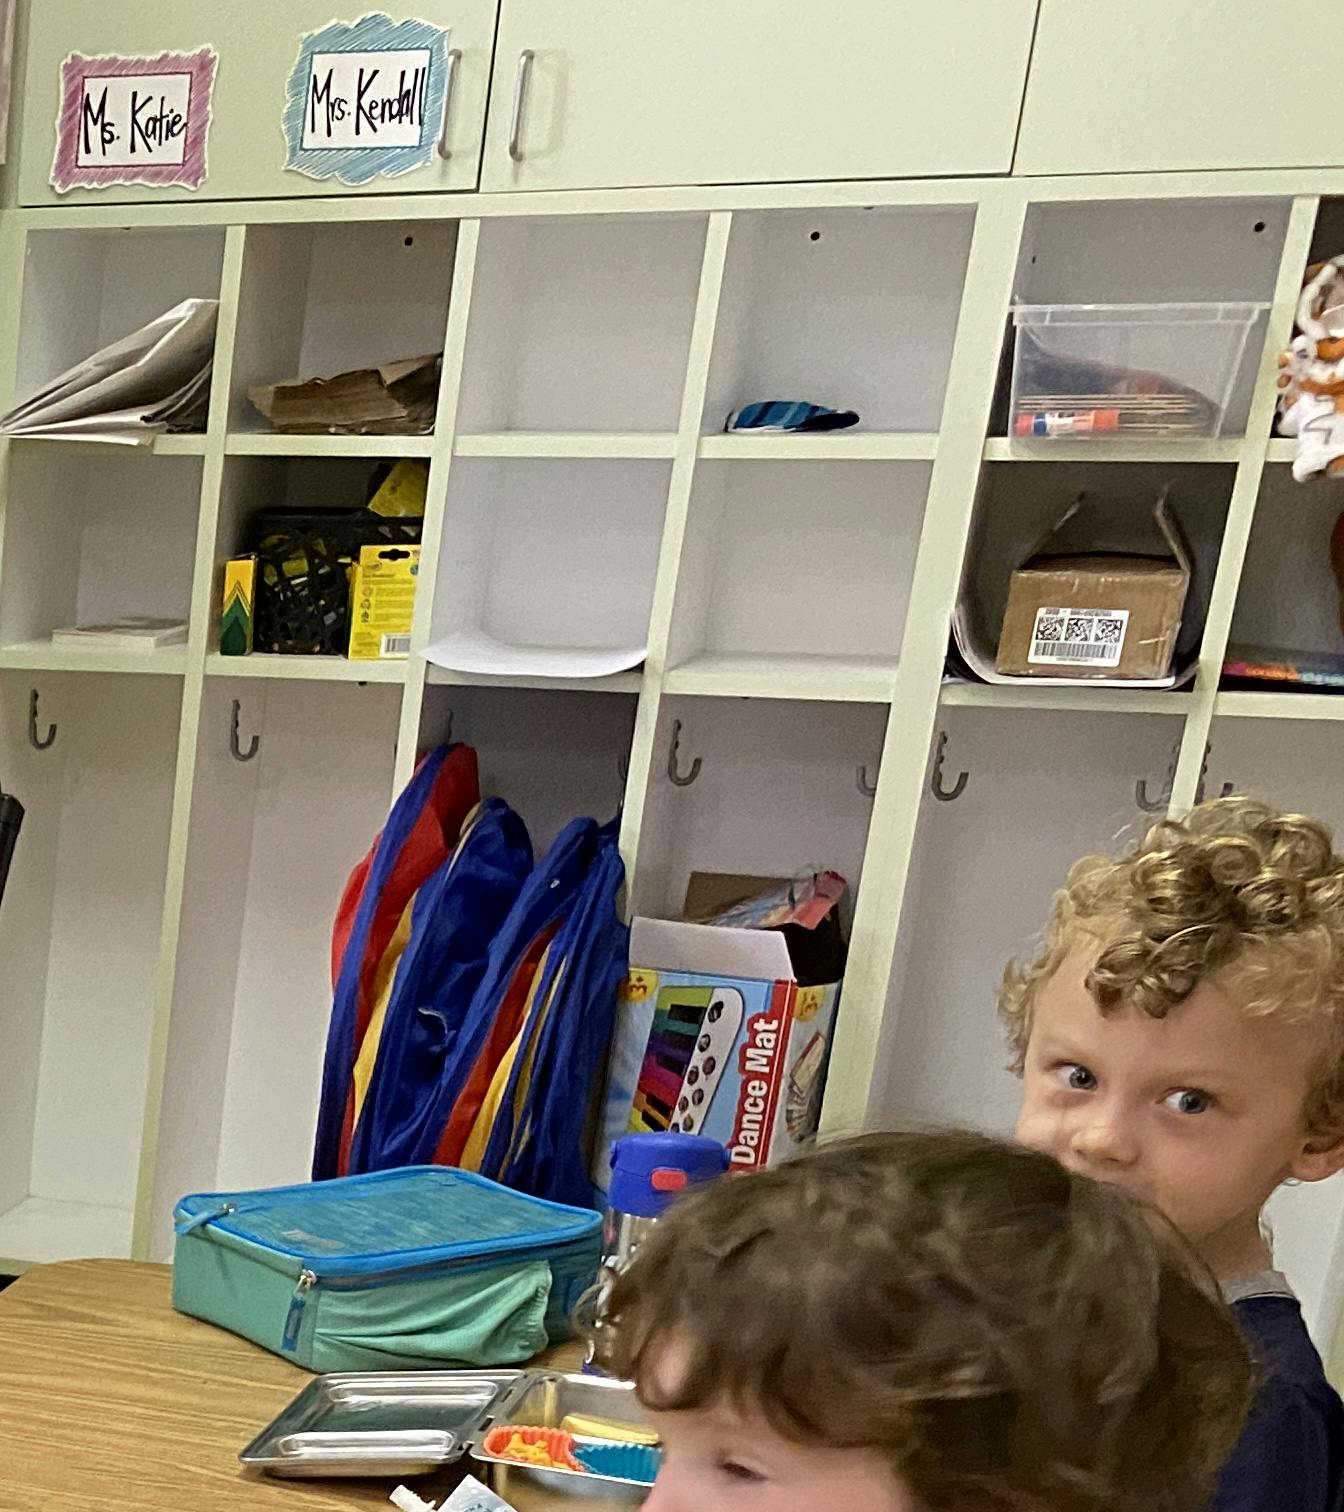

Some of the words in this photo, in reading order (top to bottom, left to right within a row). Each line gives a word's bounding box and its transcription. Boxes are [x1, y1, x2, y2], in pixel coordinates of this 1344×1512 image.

[83, 86, 121, 156] Ms.
[130, 90, 189, 154] Katie
[311, 69, 352, 138] Mrs.
[354, 66, 427, 136] Kendall
[744, 1018, 779, 1074] Mat
[730, 1079, 769, 1165] Dance
